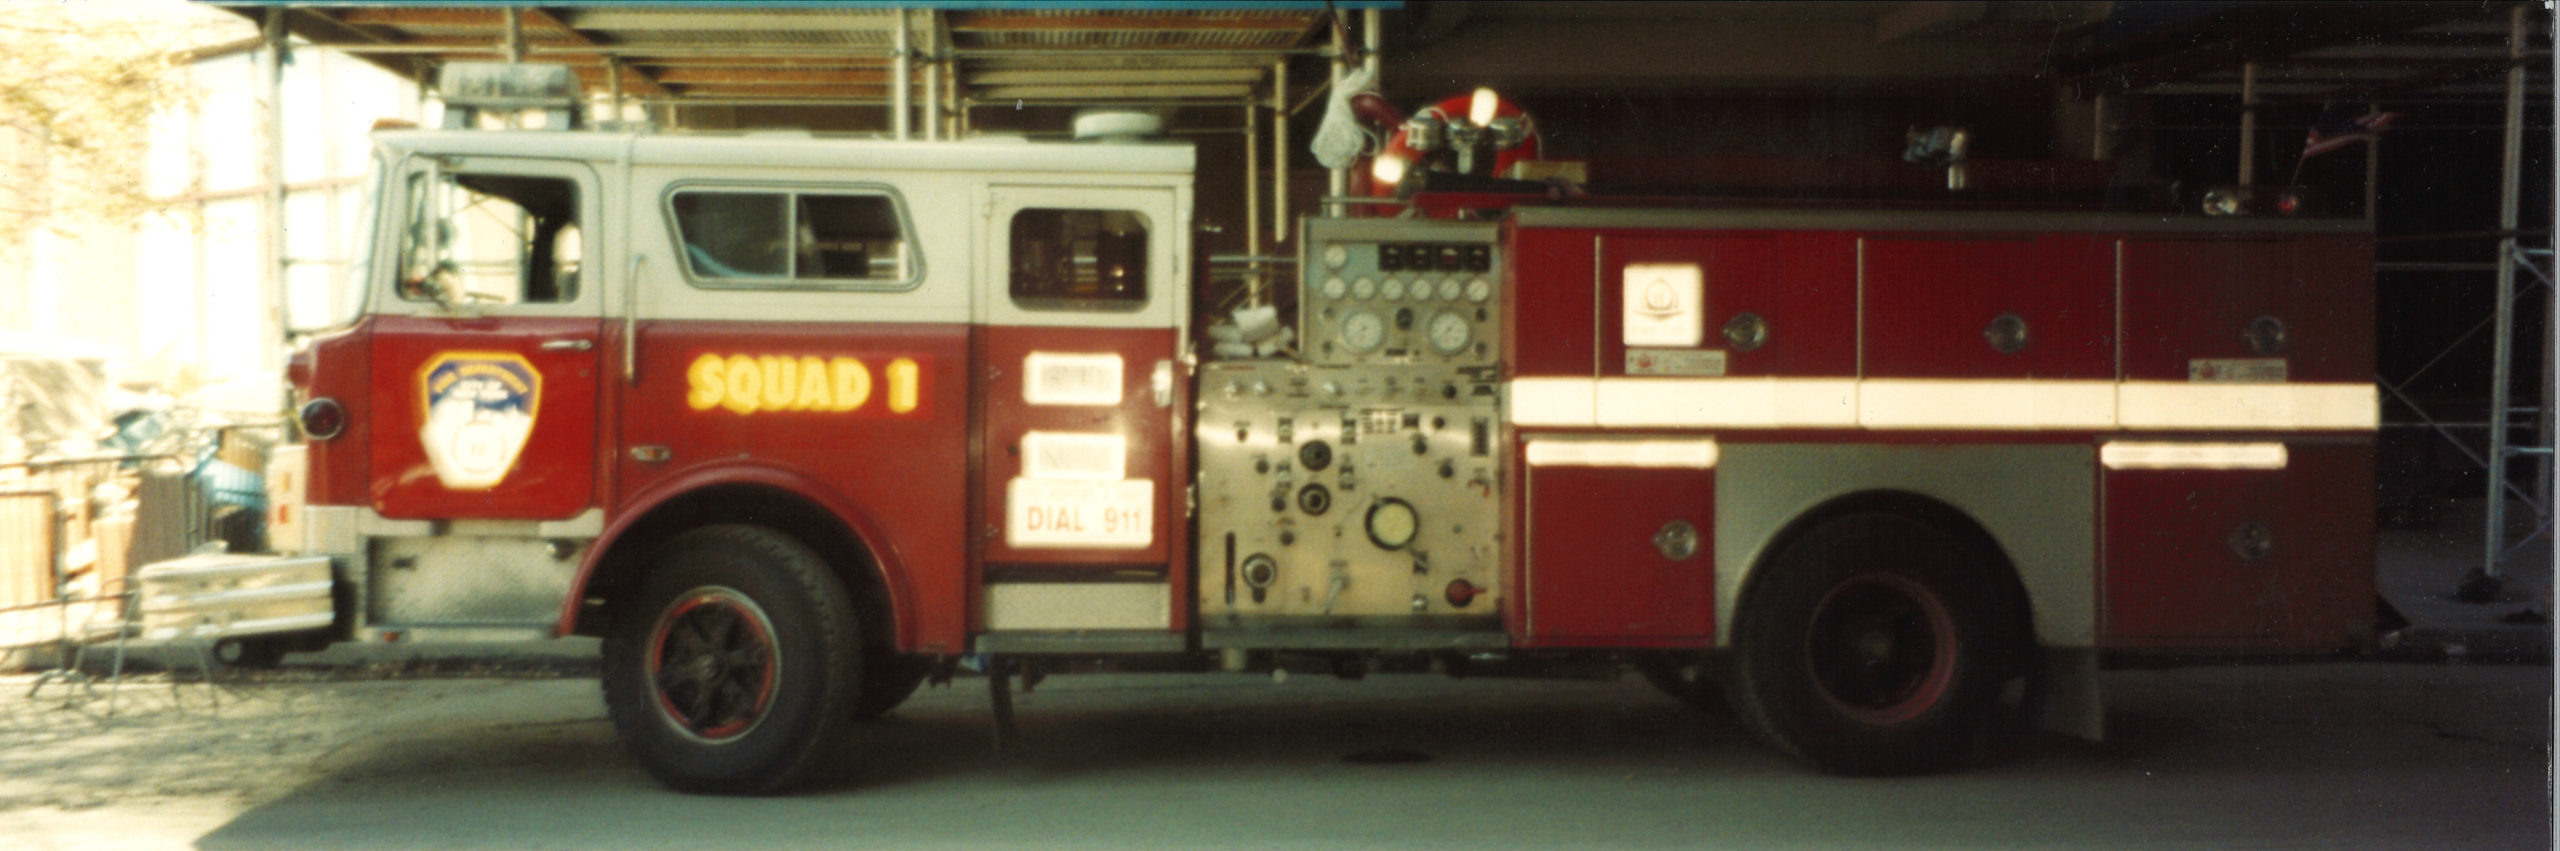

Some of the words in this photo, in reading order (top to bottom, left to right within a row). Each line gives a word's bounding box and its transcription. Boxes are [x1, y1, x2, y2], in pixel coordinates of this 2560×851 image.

[687, 353, 872, 415] SQUAD
[886, 357, 919, 413] 1
[1027, 506, 1085, 532] DIAL
[1103, 506, 1142, 533] 911
